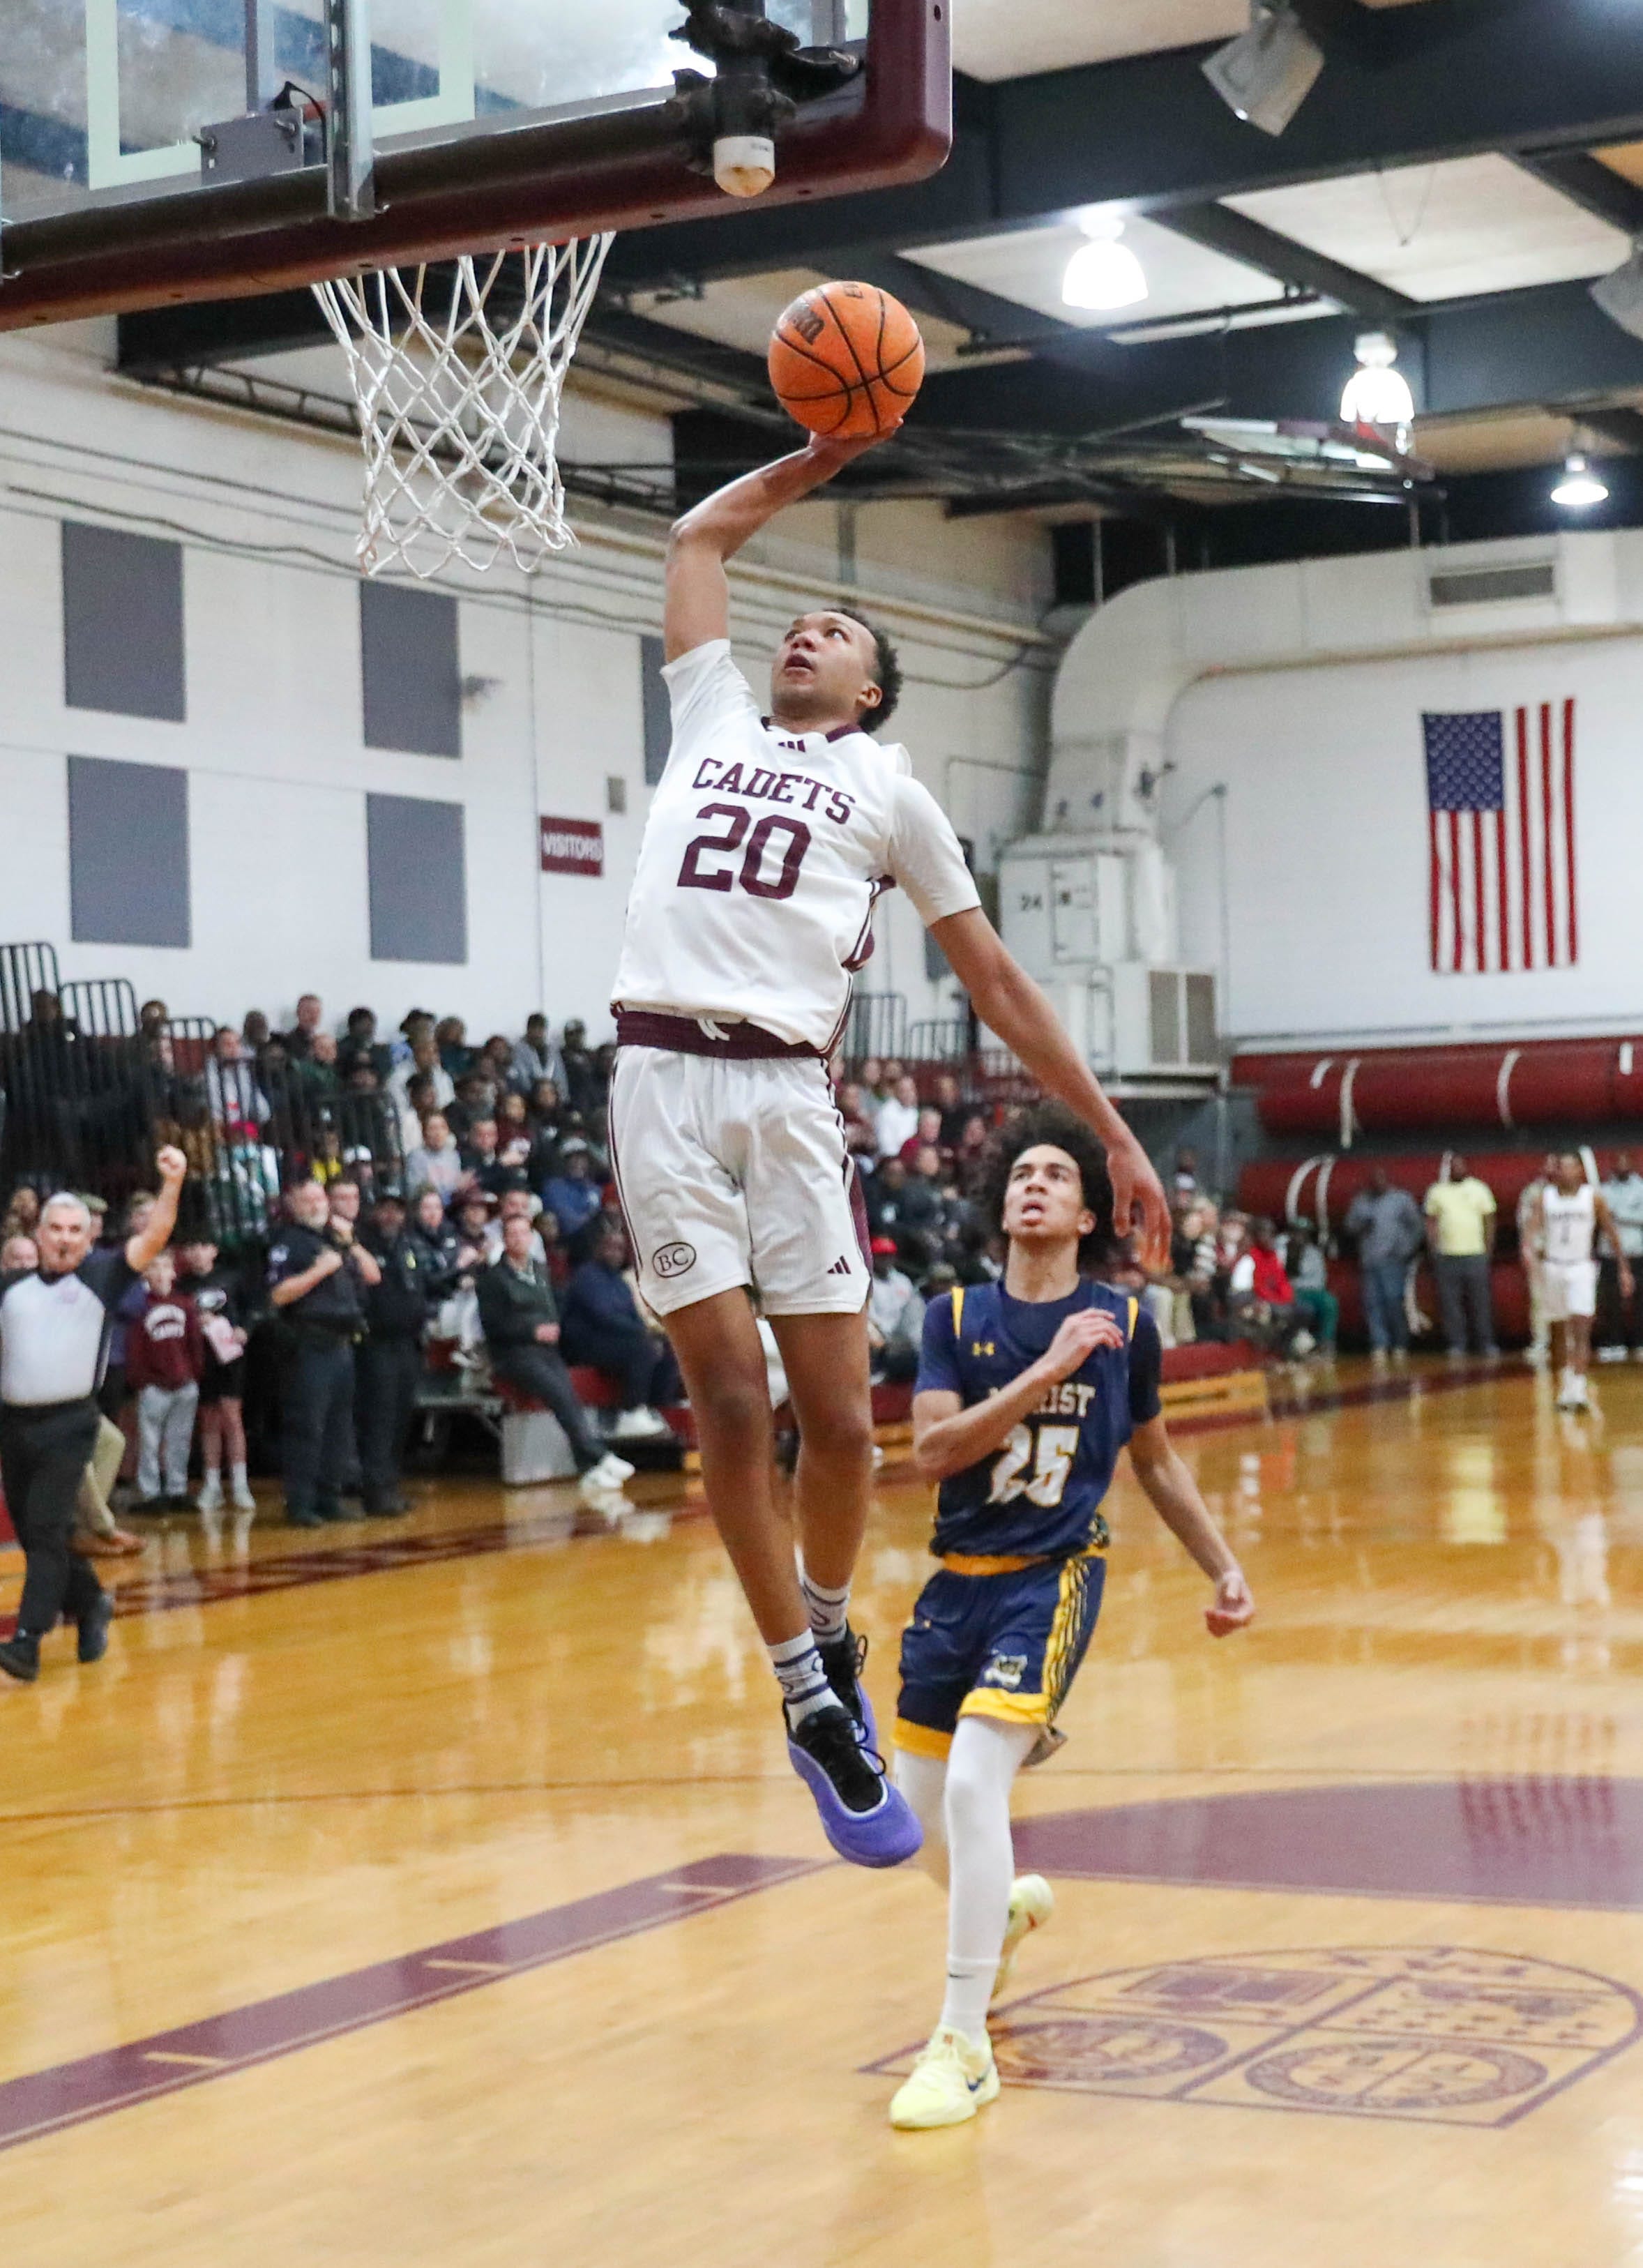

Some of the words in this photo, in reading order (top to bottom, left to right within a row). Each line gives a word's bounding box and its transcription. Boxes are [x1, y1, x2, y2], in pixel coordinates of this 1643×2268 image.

[692, 757, 856, 824] CADETS
[543, 833, 603, 861] VISITORS
[677, 803, 811, 900] 20
[657, 1248, 688, 1271] BC
[985, 1423, 1080, 1507] 25
